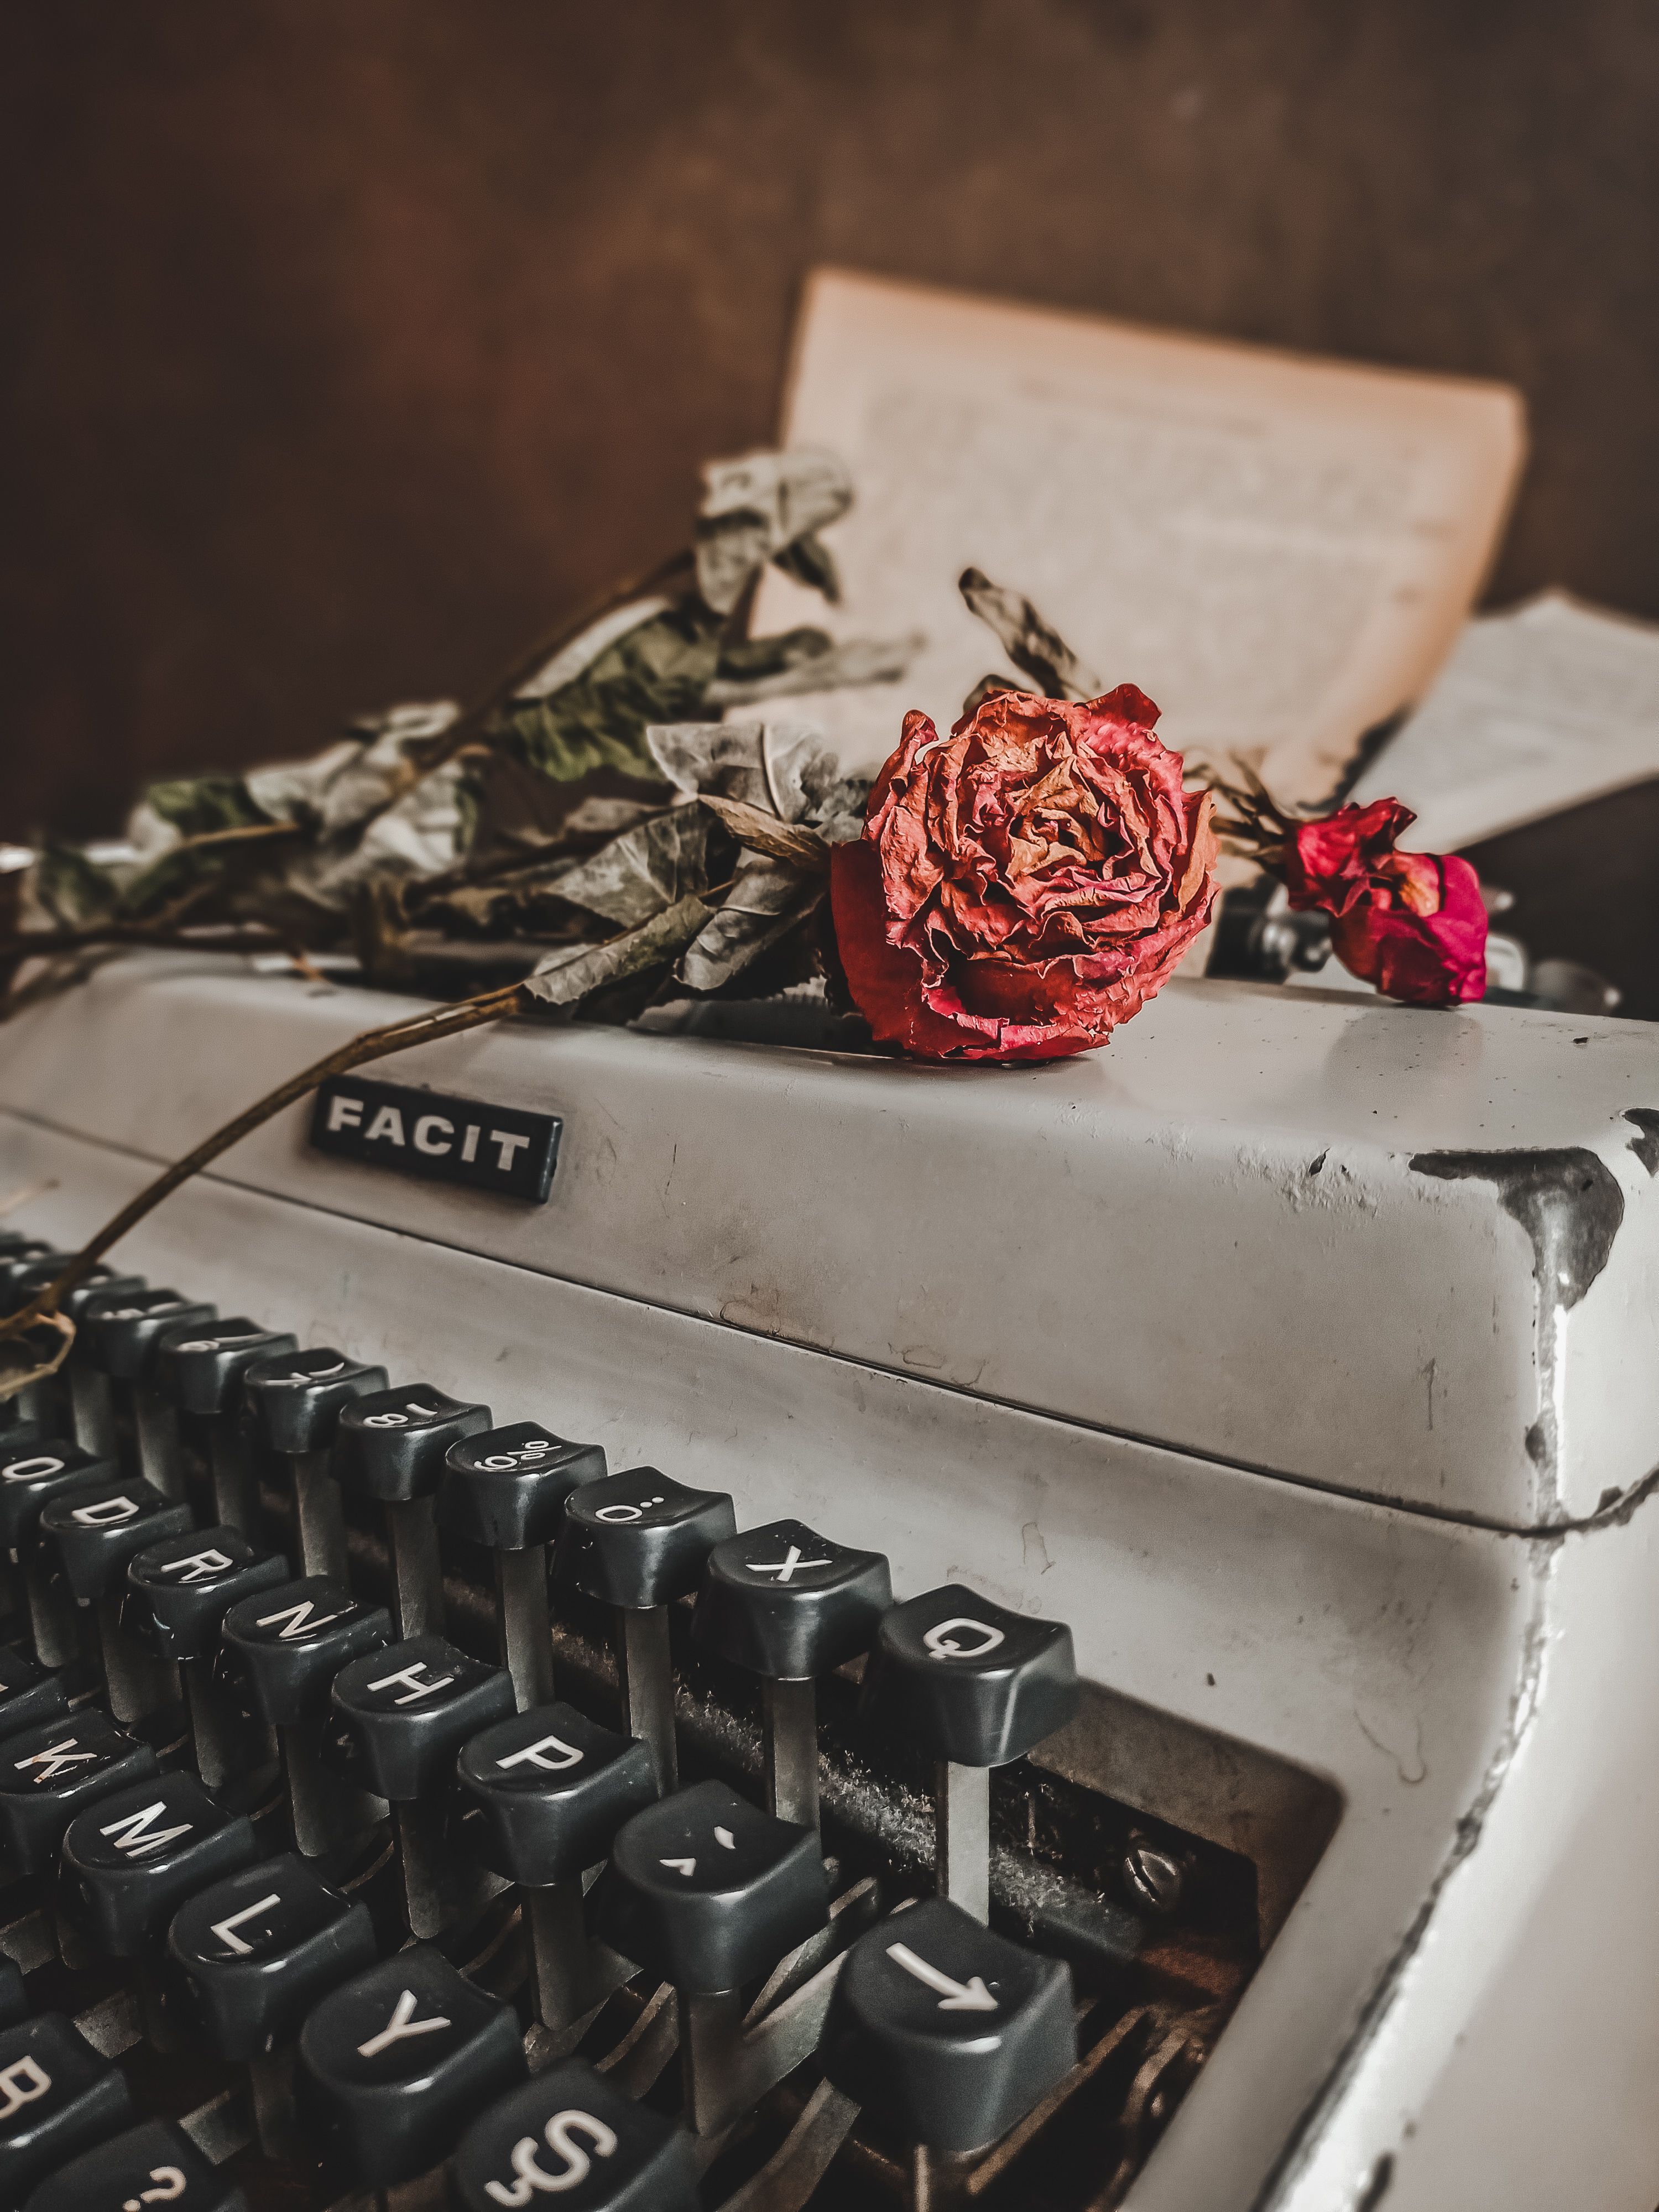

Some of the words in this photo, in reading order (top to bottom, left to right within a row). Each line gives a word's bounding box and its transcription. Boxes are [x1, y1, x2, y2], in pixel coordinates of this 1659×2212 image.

[327, 1095, 530, 1171] FACIT
[363, 1413, 408, 1427] 8
[71, 1496, 139, 1524] D
[161, 1548, 233, 1581] R
[745, 1545, 833, 1582] X
[256, 1600, 338, 1638] N
[923, 1618, 1005, 1660] Q
[367, 1662, 455, 1705] H
[14, 1738, 97, 1784] K
[495, 1735, 584, 1769] P
[99, 1801, 194, 1858] M
[210, 1893, 281, 1954] L
[357, 1989, 451, 2057] Y
[122, 2166, 187, 2212] ?
